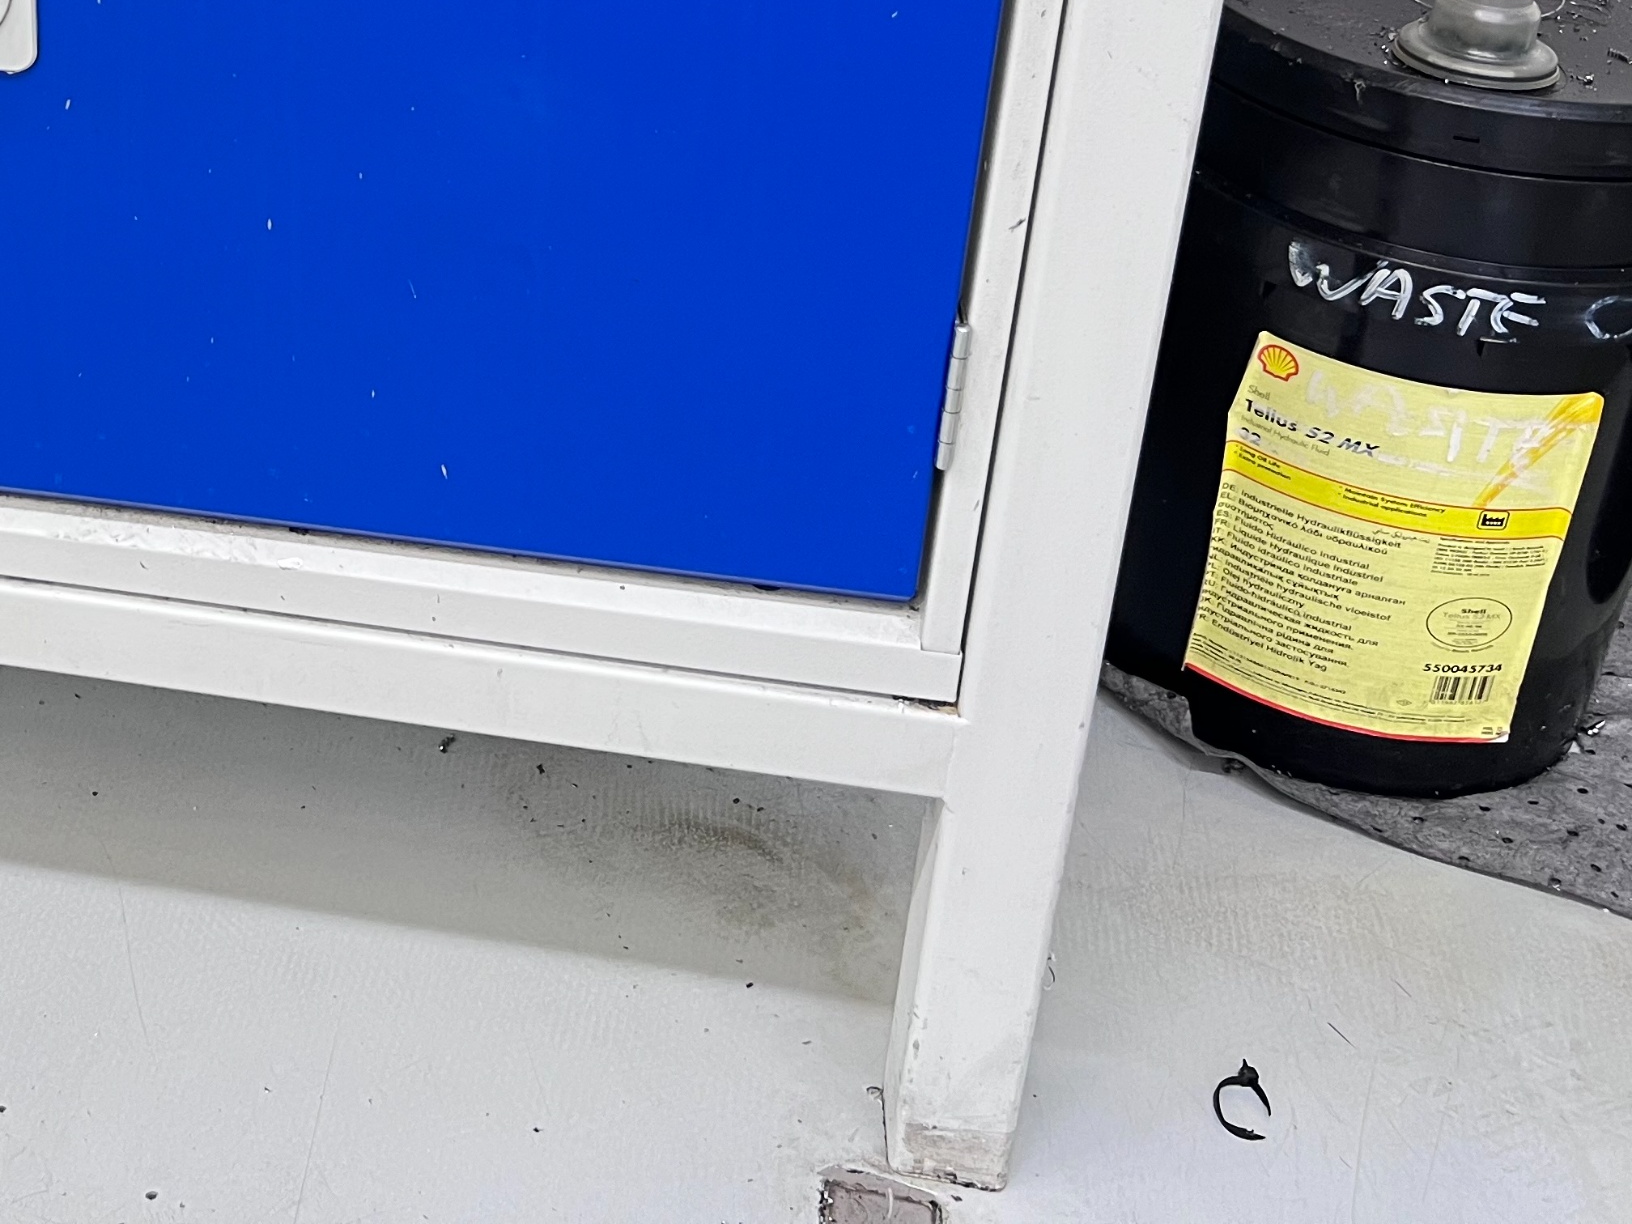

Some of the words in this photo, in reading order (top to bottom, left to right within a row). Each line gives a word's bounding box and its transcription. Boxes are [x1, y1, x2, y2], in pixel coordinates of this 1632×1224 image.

[1289, 240, 1546, 343] WASTE
[1248, 384, 1270, 401] Shell
[1305, 426, 1335, 445] S2
[1336, 437, 1380, 457] MX
[1310, 443, 1331, 457] Fluid
[1241, 489, 1295, 518] Industrielle
[1233, 525, 1267, 545] Liquide
[1270, 542, 1330, 569] Hydraulique
[1333, 564, 1384, 583] industriel
[1235, 515, 1264, 534] Fluido
[1320, 550, 1370, 570] industrial
[1227, 531, 1256, 550] Fluido
[1258, 546, 1300, 569] idraulico
[1303, 564, 1358, 586] industriale
[1223, 567, 1240, 583] Olej
[1243, 577, 1305, 609] hydrauliczny
[1276, 582, 1343, 610] hydraulische
[1303, 611, 1352, 632] industrial
[1422, 662, 1503, 674] 550045734
